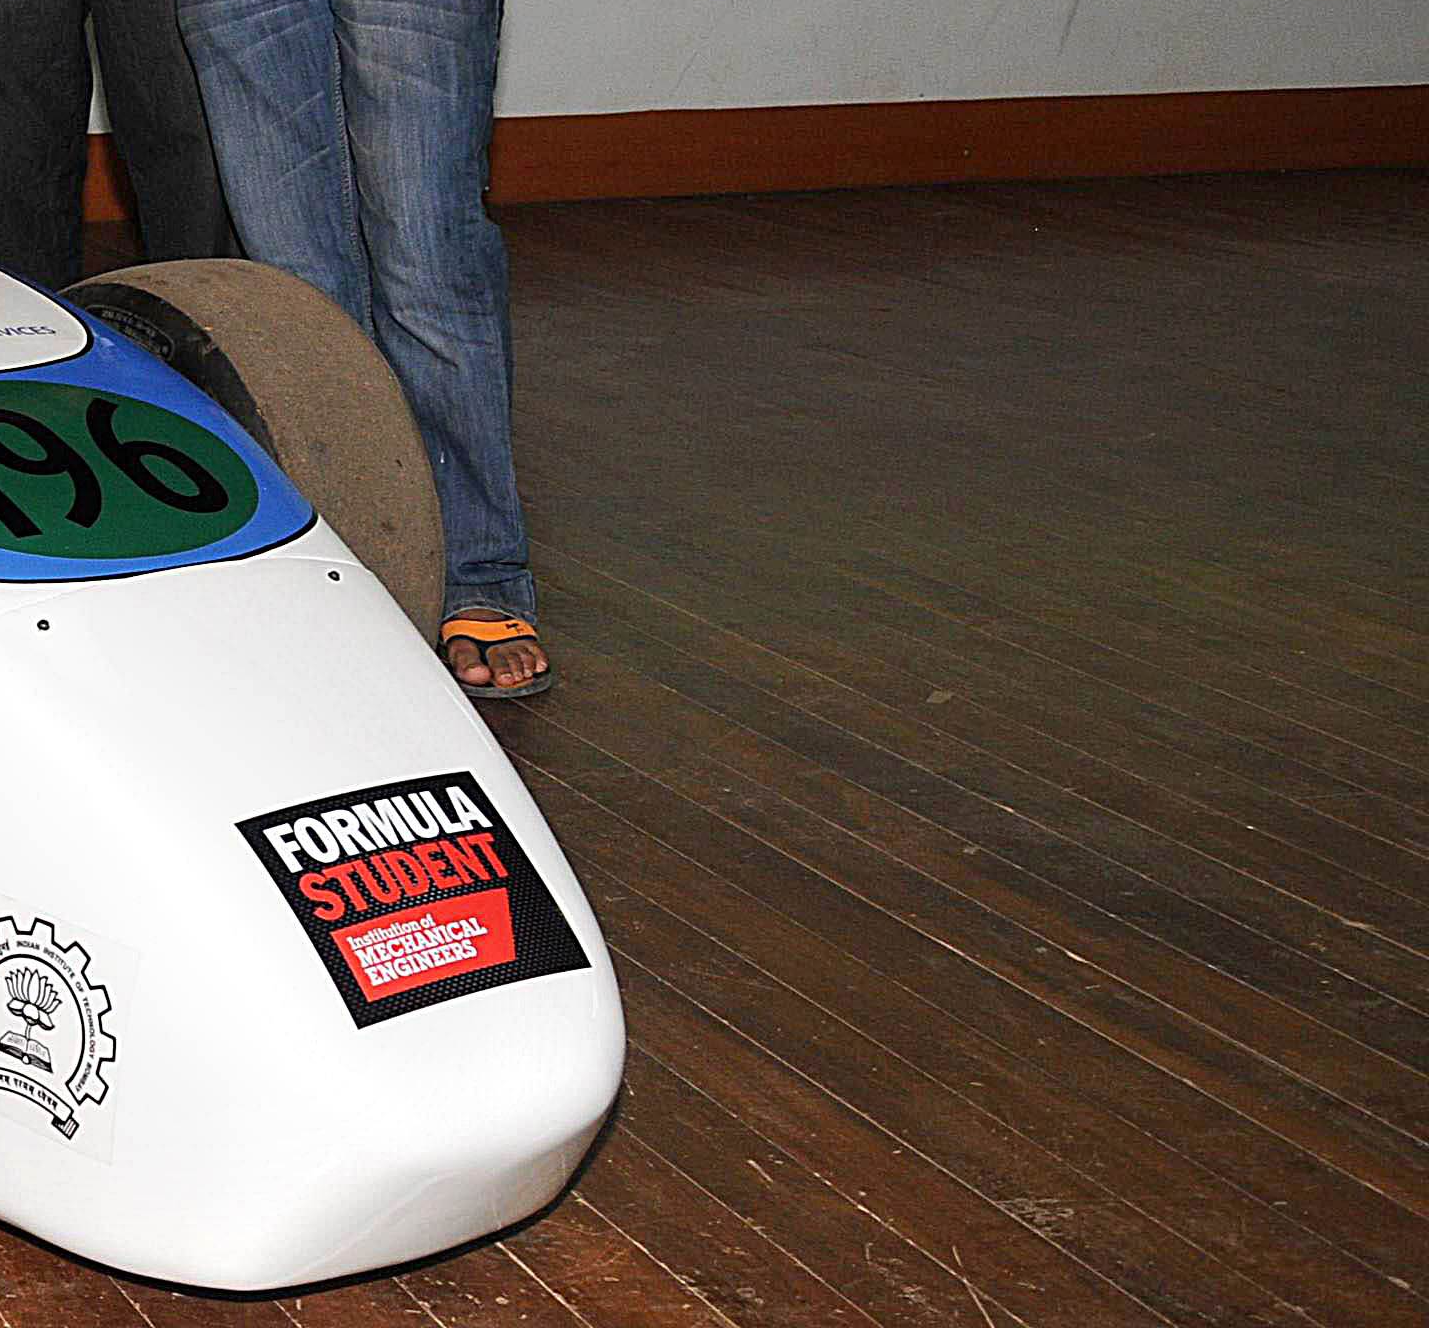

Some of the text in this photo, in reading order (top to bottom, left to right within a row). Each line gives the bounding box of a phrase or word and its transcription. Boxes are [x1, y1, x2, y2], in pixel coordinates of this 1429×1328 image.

[263, 785, 492, 874] FORMULA
[298, 832, 508, 922] STUDENT
[346, 913, 437, 951] Institution of
[353, 917, 488, 969] MECHANICAL
[364, 939, 478, 987] ENGINEERS
